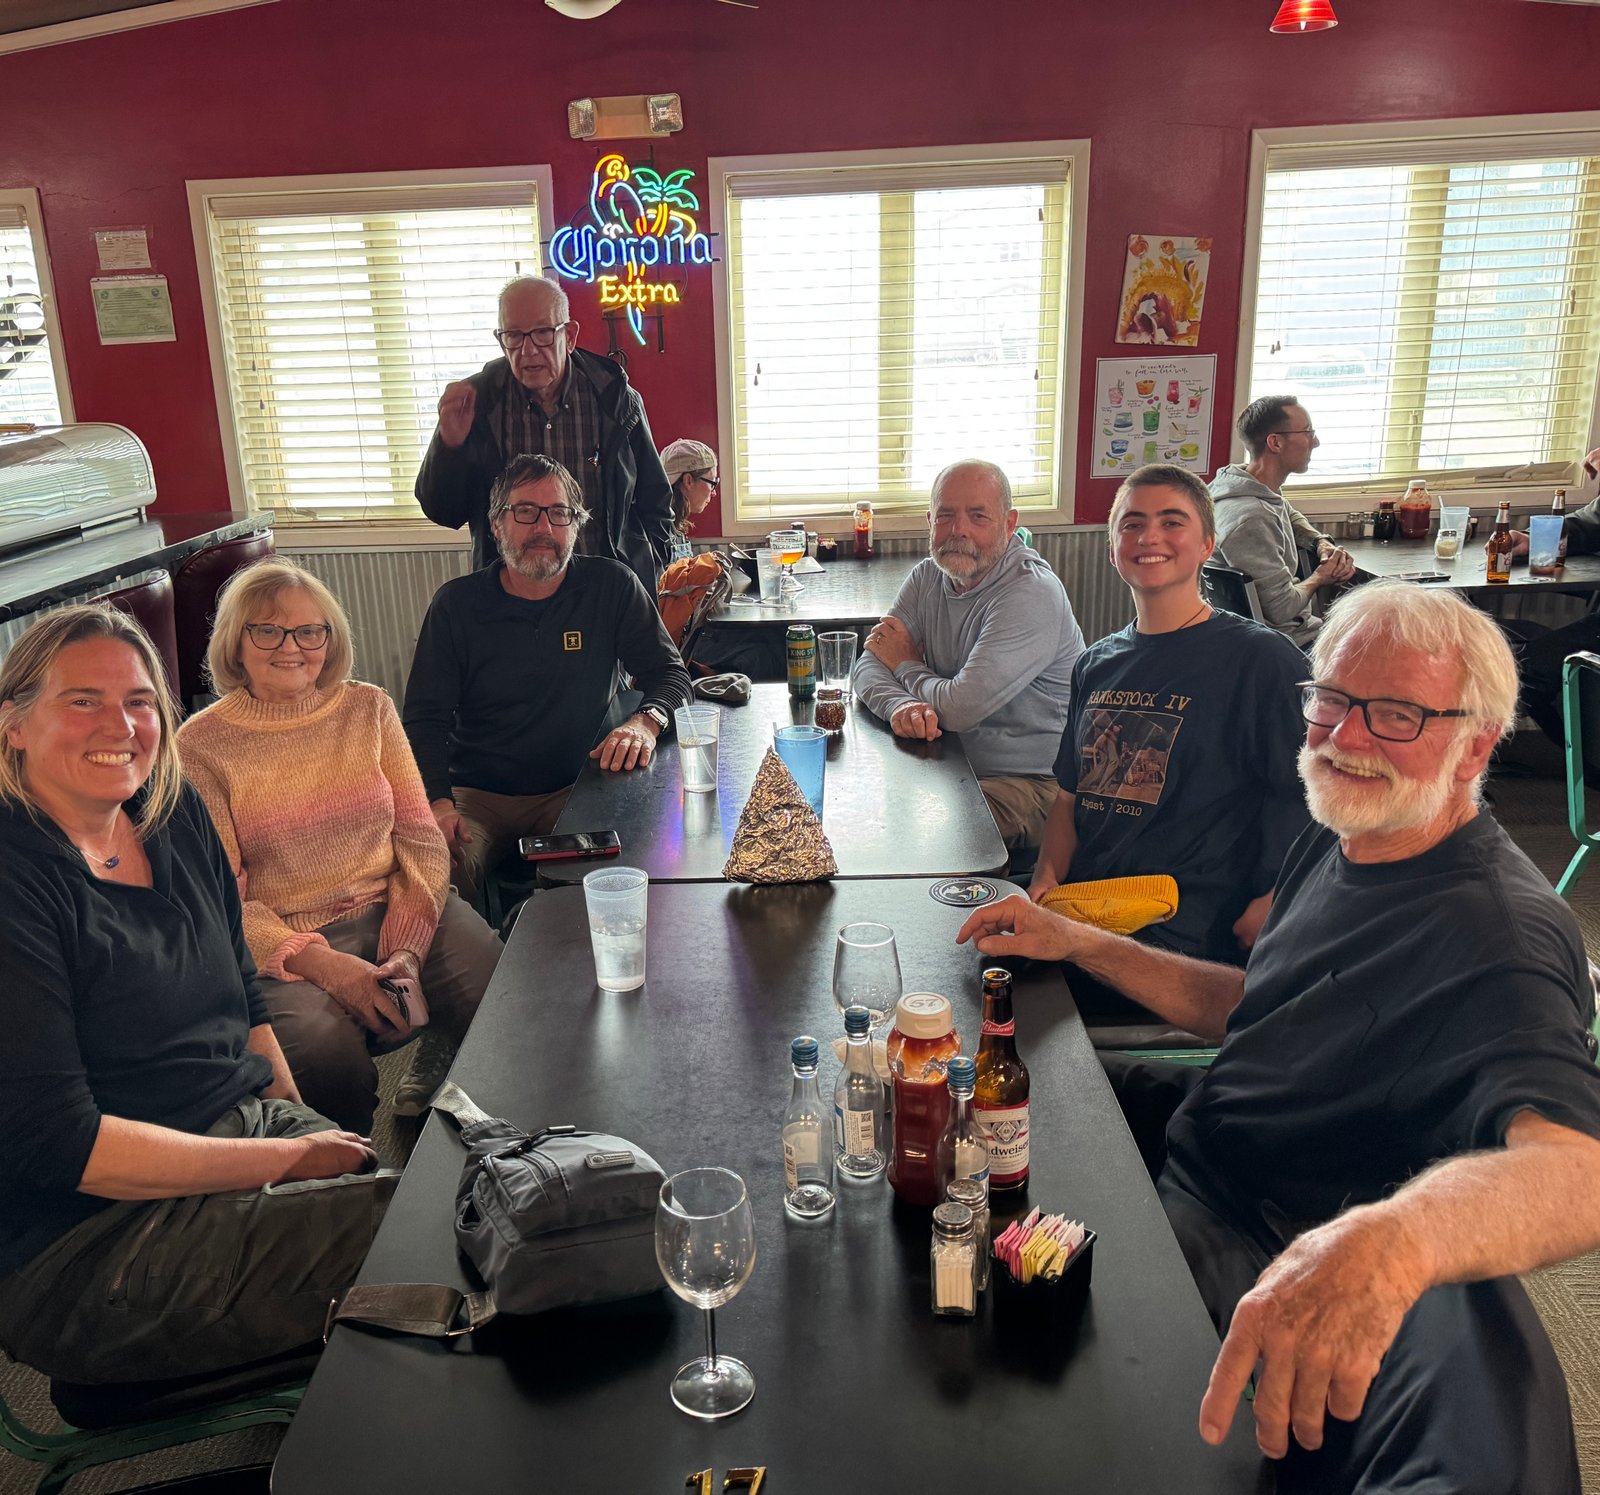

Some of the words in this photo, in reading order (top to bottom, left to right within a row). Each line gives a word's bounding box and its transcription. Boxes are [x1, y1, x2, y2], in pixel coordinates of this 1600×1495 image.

[549, 224, 713, 284] Corona
[597, 274, 680, 303] Extra
[790, 649, 807, 657] KING
[1164, 694, 1192, 711] IV
[1115, 803, 1143, 817] 2010
[909, 998, 939, 1008] 57
[988, 1139, 1030, 1157] dweiser
